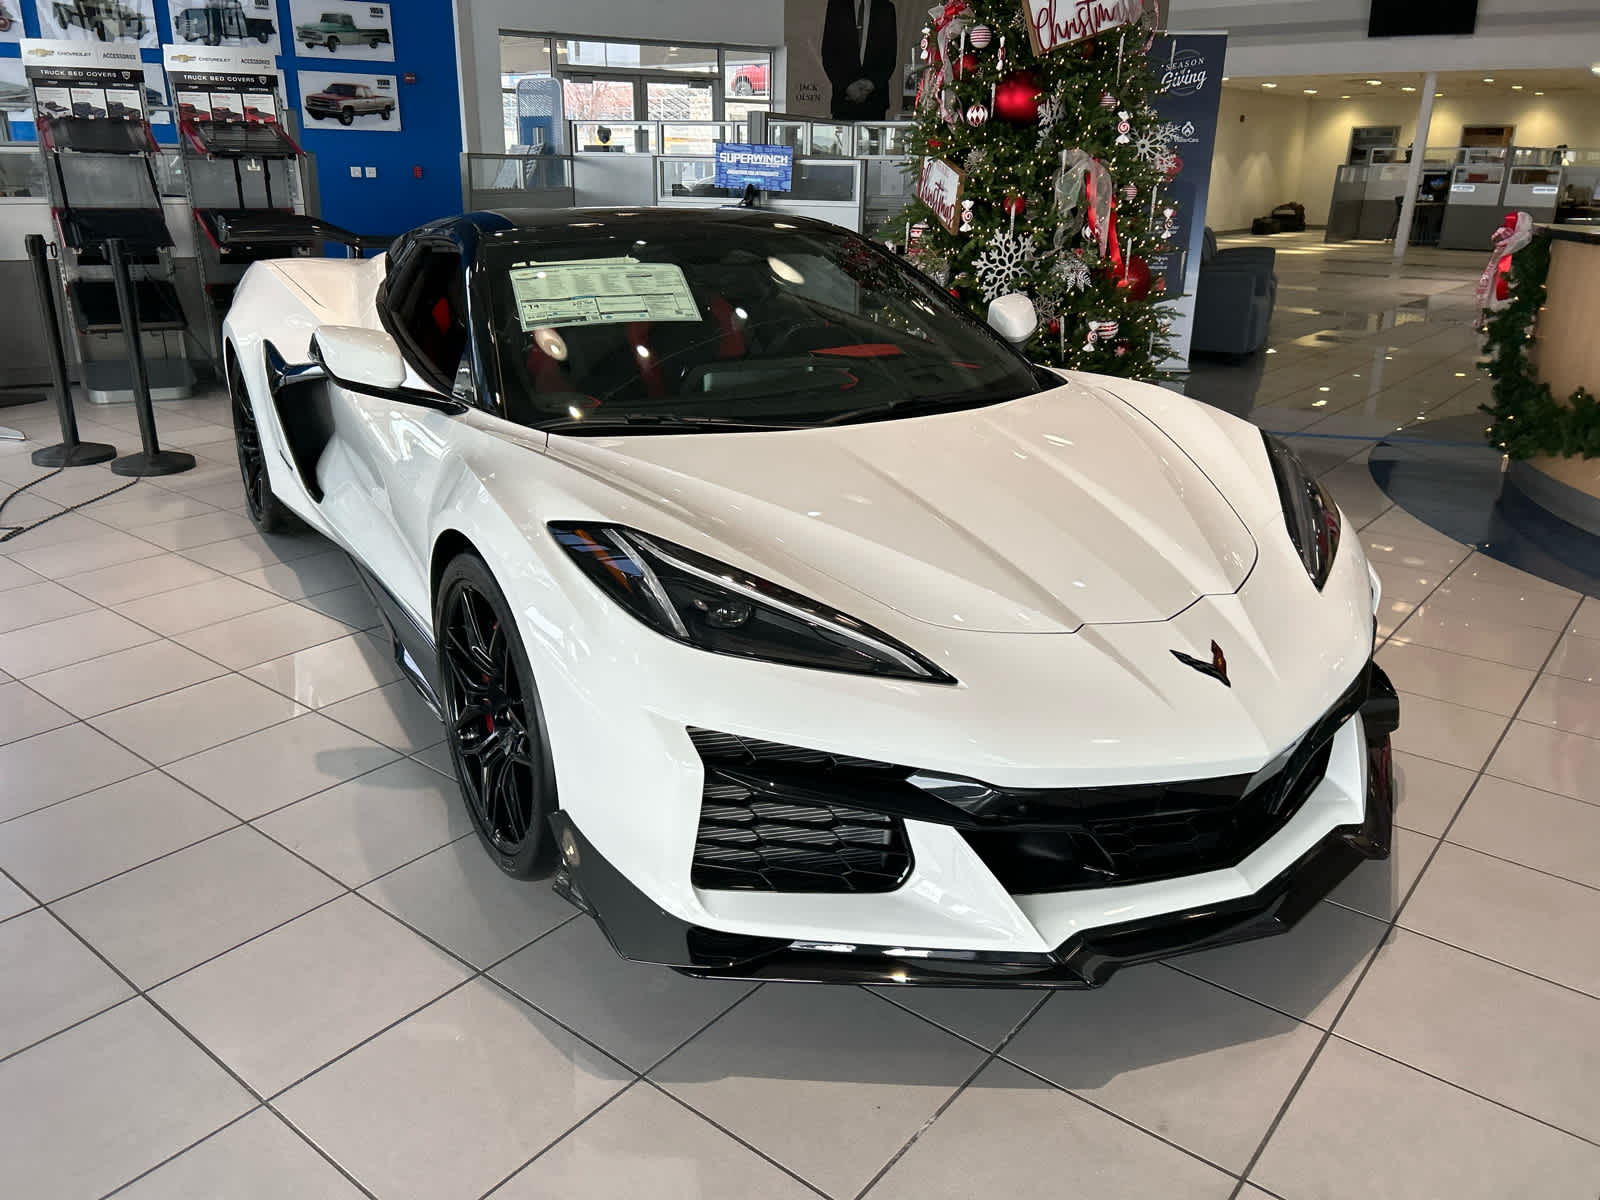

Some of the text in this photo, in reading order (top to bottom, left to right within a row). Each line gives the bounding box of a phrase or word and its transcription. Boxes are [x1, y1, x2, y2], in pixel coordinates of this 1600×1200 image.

[1165, 57, 1205, 71] SEASON
[799, 83, 818, 91] JACK
[1160, 70, 1207, 91] Giving
[795, 94, 821, 102] OLSEN
[719, 152, 788, 165] SUPERWINCH
